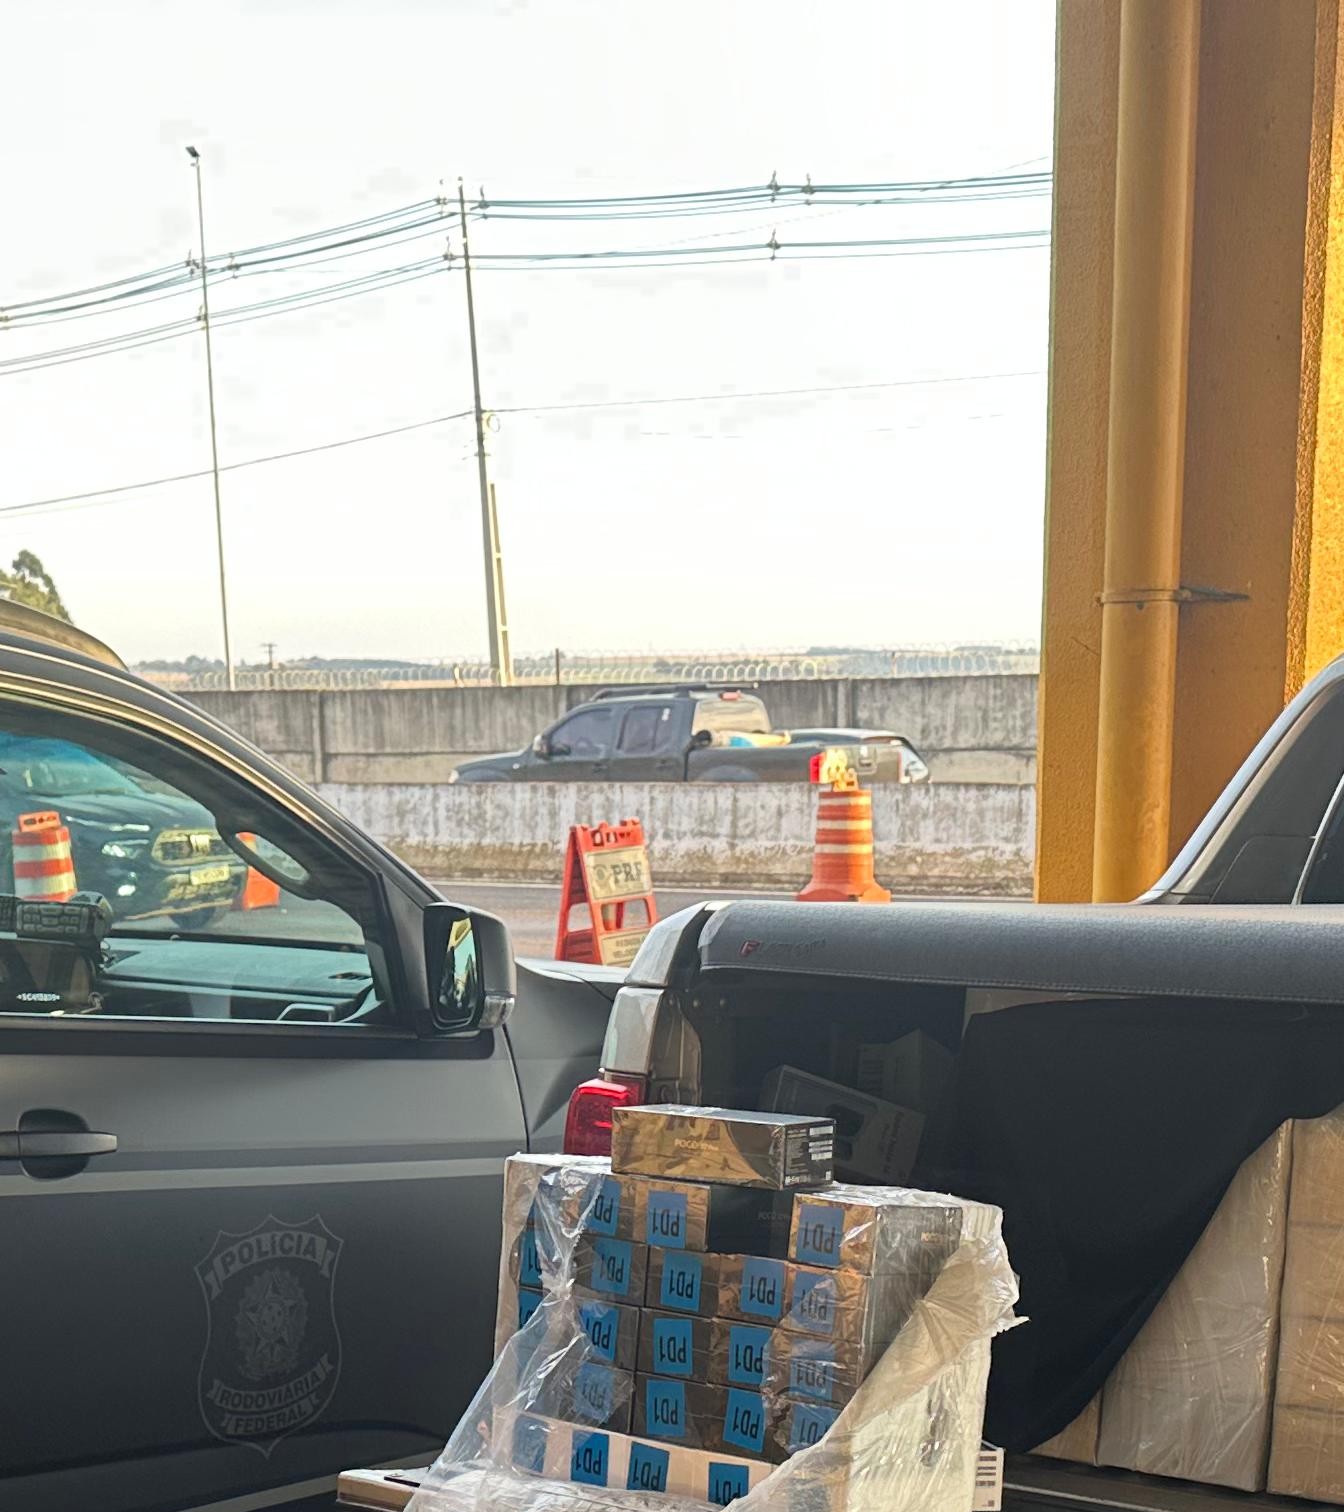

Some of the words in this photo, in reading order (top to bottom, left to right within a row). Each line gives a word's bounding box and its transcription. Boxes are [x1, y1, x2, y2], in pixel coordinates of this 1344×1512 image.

[652, 1207, 680, 1232] PD1
[802, 1221, 836, 1254] PD1
[599, 1254, 624, 1284] PD1
[668, 1268, 695, 1298] PD1
[749, 1275, 776, 1305] PD1
[799, 1288, 829, 1321] PD1
[659, 1336, 687, 1364] PD1
[735, 1343, 763, 1375] PD1
[653, 1397, 679, 1425] PD1
[732, 1406, 761, 1440] PD1
[575, 1447, 602, 1475] PD1
[632, 1457, 662, 1492] PD1
